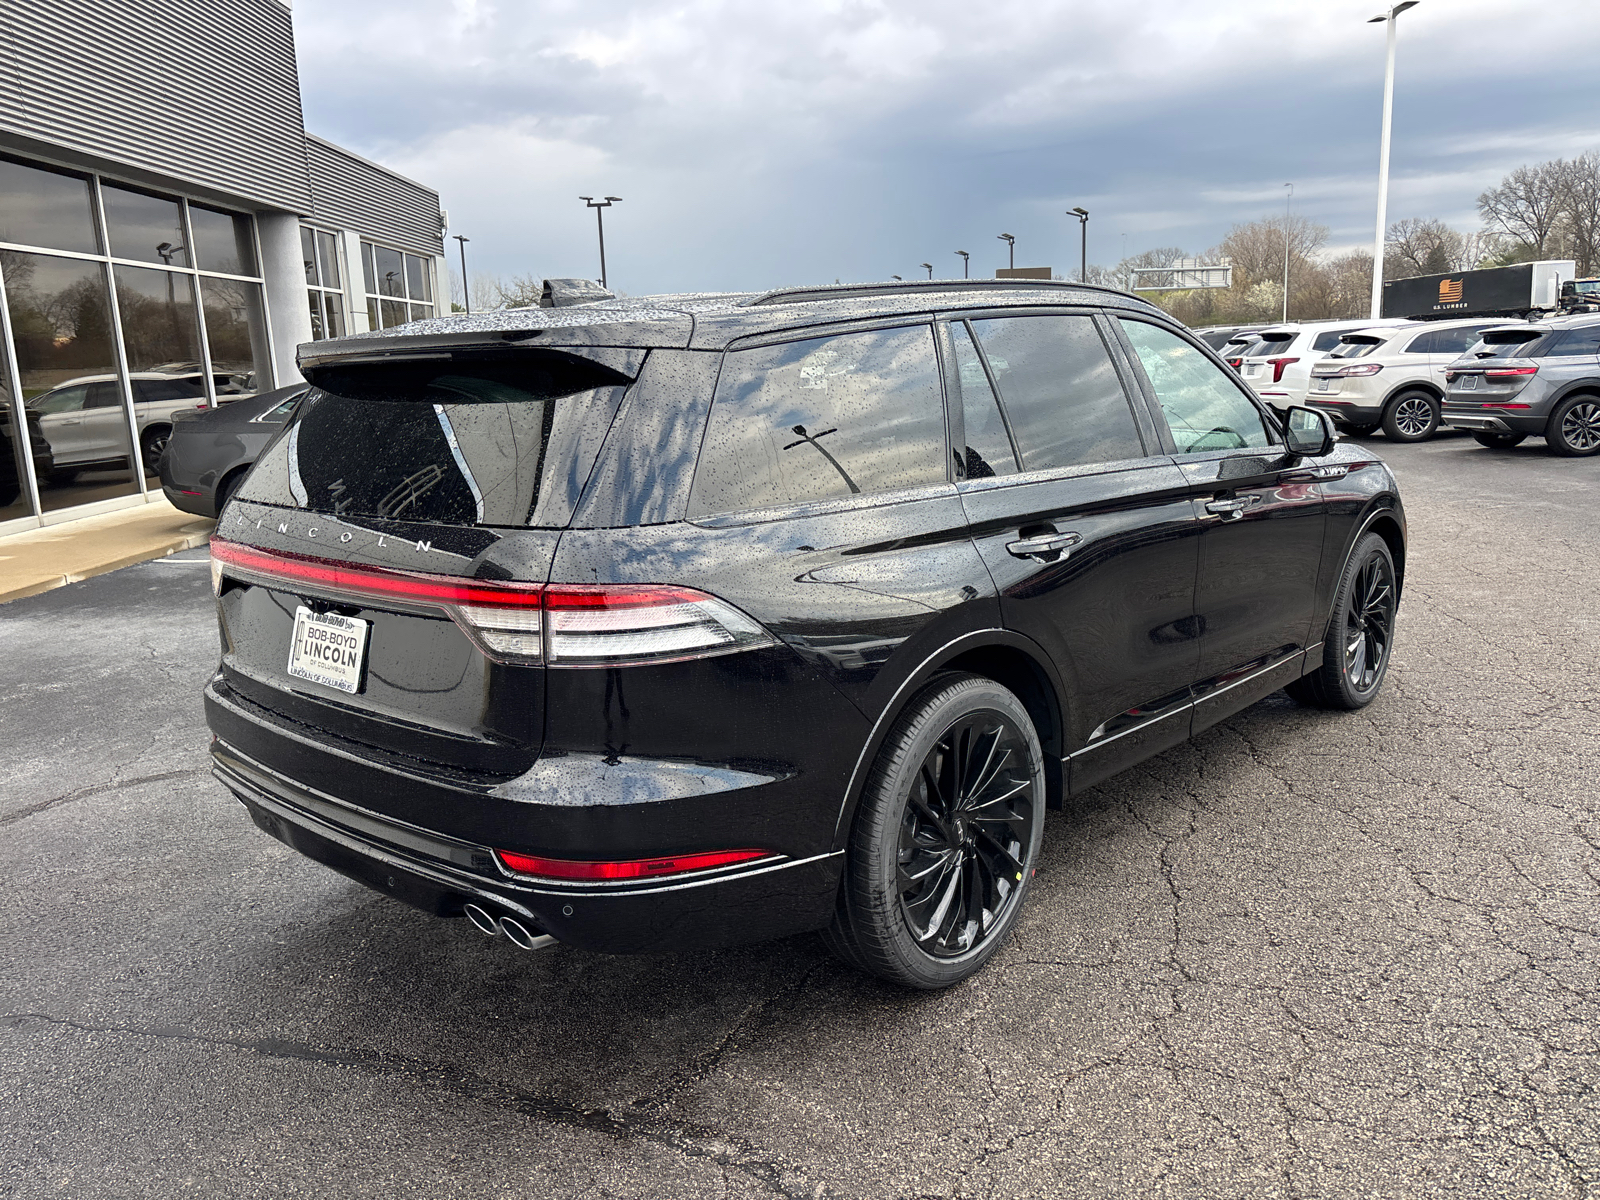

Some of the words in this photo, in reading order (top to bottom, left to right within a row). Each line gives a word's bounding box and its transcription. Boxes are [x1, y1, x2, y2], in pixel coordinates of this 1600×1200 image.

[1442, 302, 1468, 310] LUMBER
[236, 516, 431, 552] LINCOLN
[307, 627, 357, 649] BOB-BOYD
[303, 639, 357, 668] LINCOLN
[309, 658, 317, 666] OF
[317, 661, 346, 674] COLUMBUS
